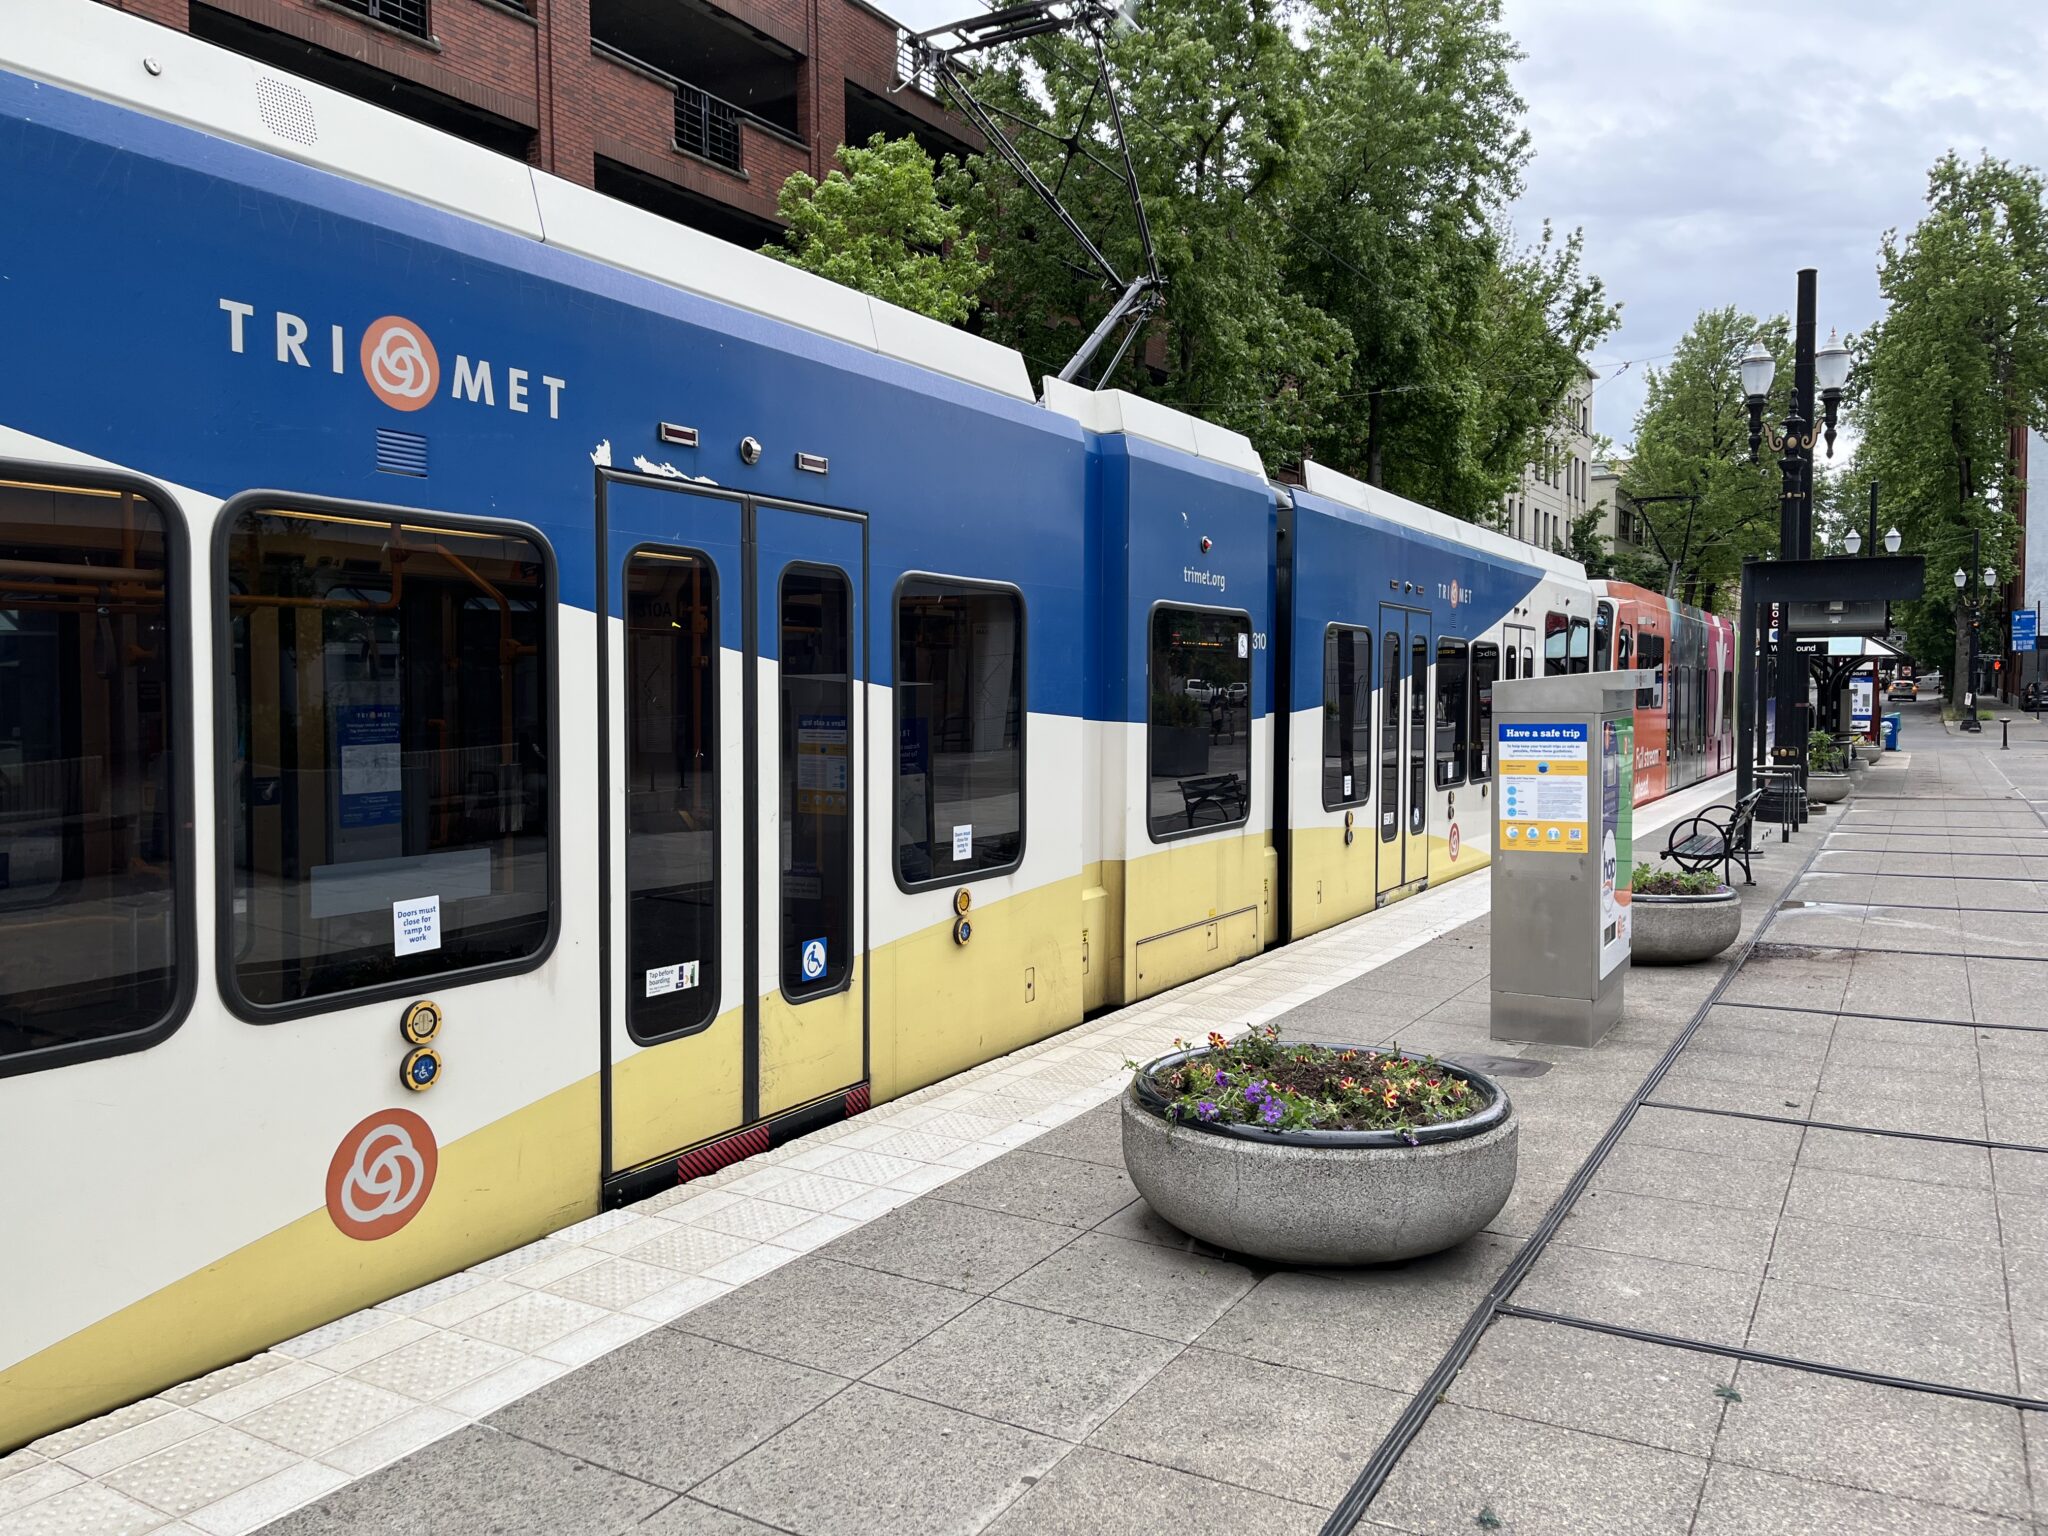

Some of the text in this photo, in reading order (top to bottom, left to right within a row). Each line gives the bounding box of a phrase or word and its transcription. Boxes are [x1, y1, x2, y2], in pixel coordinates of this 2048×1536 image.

[219, 297, 567, 420] TRI MET
[1183, 566, 1226, 592] trimet.org
[1437, 583, 1472, 604] TRI MET
[1252, 632, 1267, 650] 310
[1506, 729, 1530, 738] Have
[1540, 729, 1560, 738] safe
[1562, 729, 1581, 739] trip
[1603, 850, 1616, 891] hop
[397, 906, 436, 919] Doors must
[403, 918, 420, 927] close
[404, 926, 423, 935] ramp
[409, 934, 427, 943] work
[659, 969, 674, 977] before
[649, 977, 671, 986] boarding
